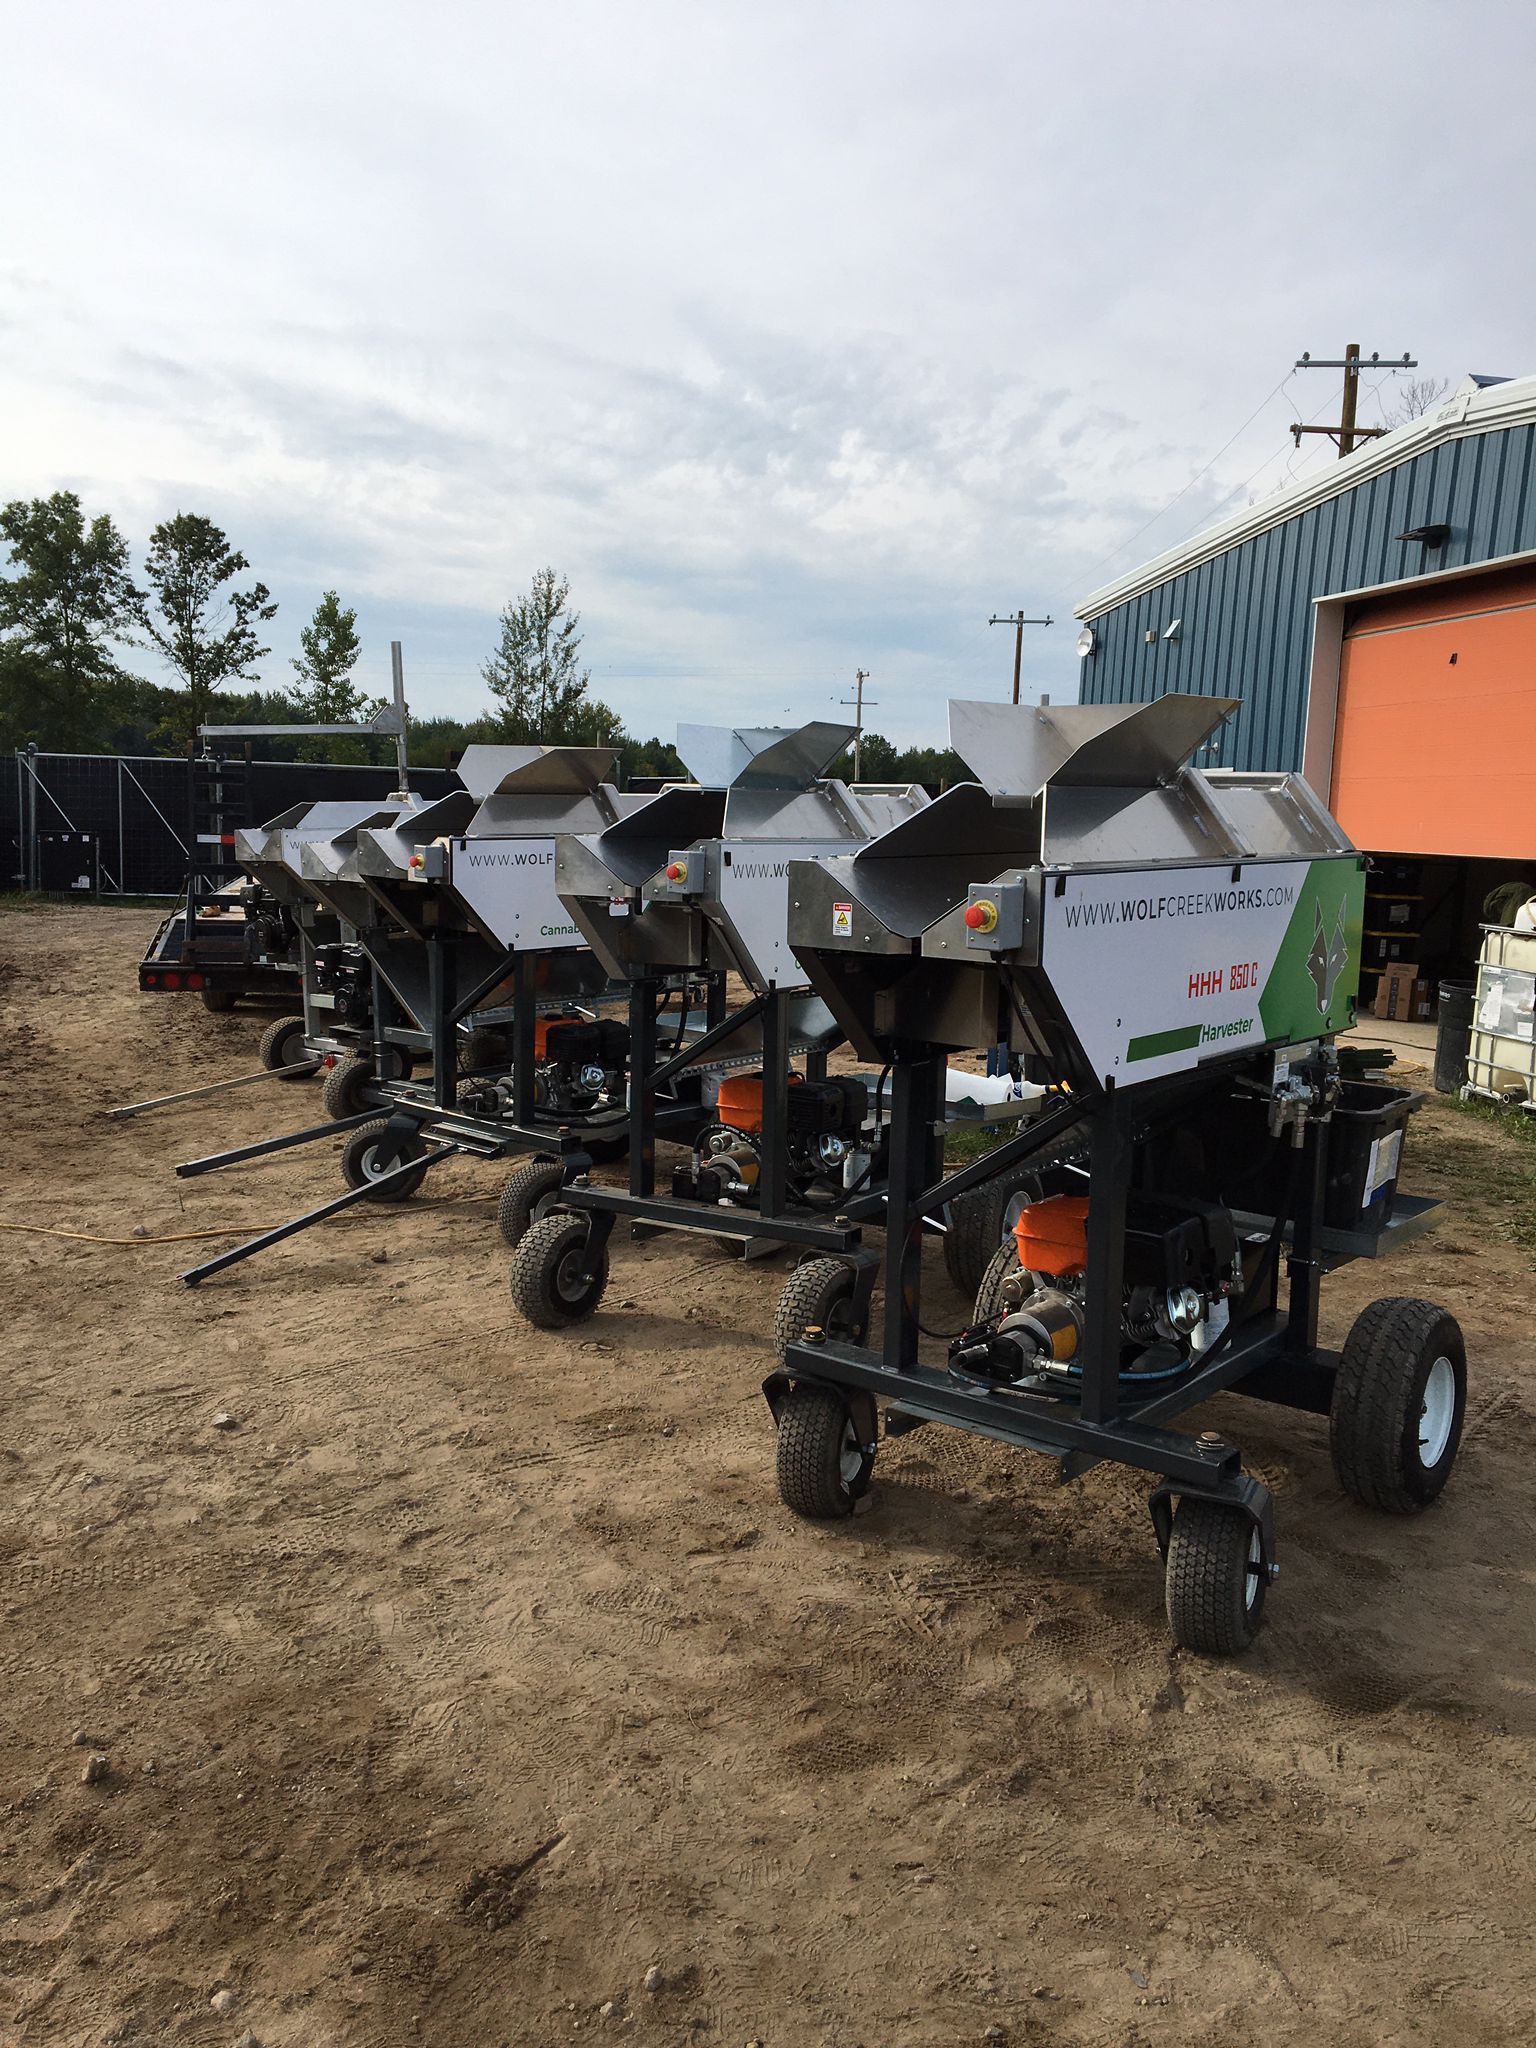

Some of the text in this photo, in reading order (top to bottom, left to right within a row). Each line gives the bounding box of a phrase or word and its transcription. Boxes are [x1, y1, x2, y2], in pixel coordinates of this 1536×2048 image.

[1065, 886, 1294, 929] WWW.WOLFCREEKWORKS.COM
[1188, 969, 1223, 999] HHH
[1201, 1018, 1254, 1043] Harvester
